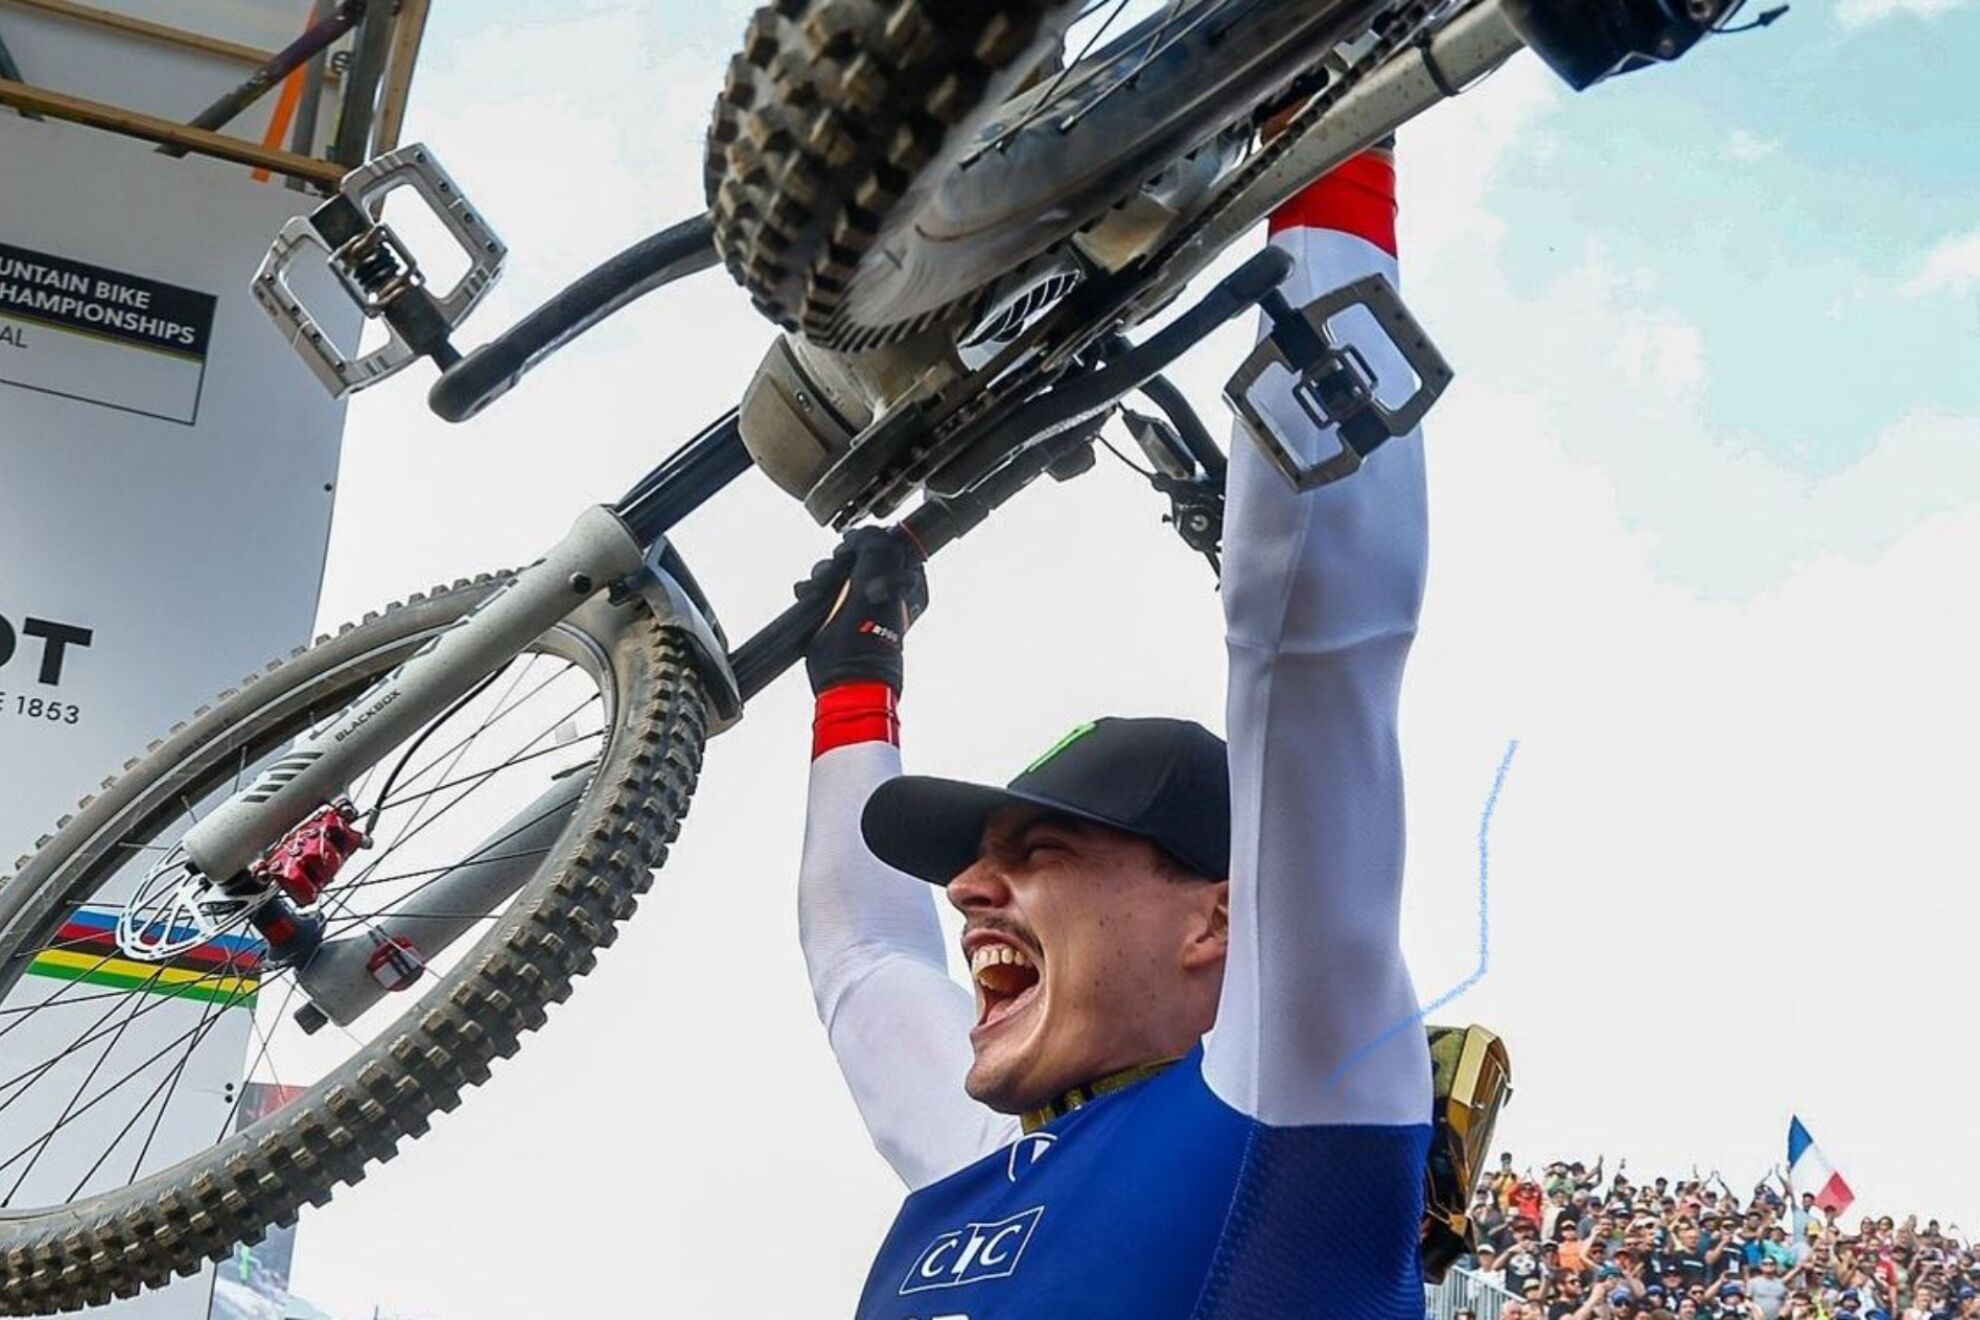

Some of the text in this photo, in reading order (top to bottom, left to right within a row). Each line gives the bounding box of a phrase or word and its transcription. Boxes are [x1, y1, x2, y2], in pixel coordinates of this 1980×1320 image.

[0, 256, 151, 309] UNTAIN BIKE
[0, 282, 196, 345] HAMPIONSHIPS
[0, 325, 28, 348] AL
[17, 696, 80, 724] 1853
[335, 689, 402, 742] BLACKBOX
